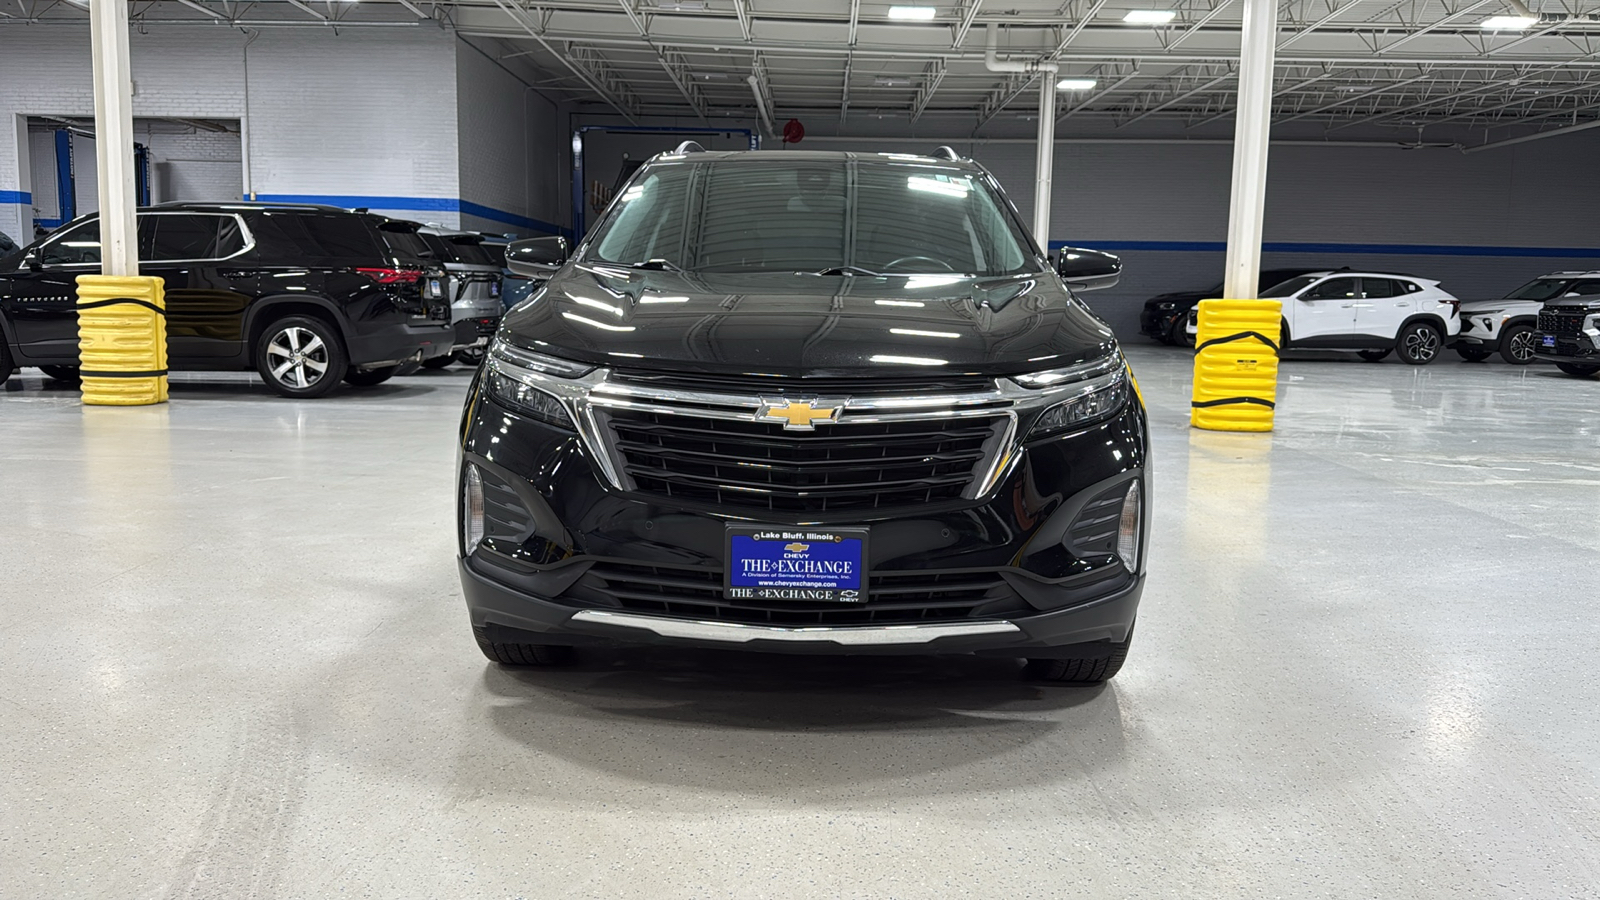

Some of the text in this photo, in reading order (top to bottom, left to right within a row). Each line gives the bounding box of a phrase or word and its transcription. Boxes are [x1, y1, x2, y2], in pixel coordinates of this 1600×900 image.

[741, 558, 852, 574] THE EXCHANGE
[758, 580, 837, 588] www.chevyexchange.com
[729, 588, 833, 600] THE EXCHANGE
